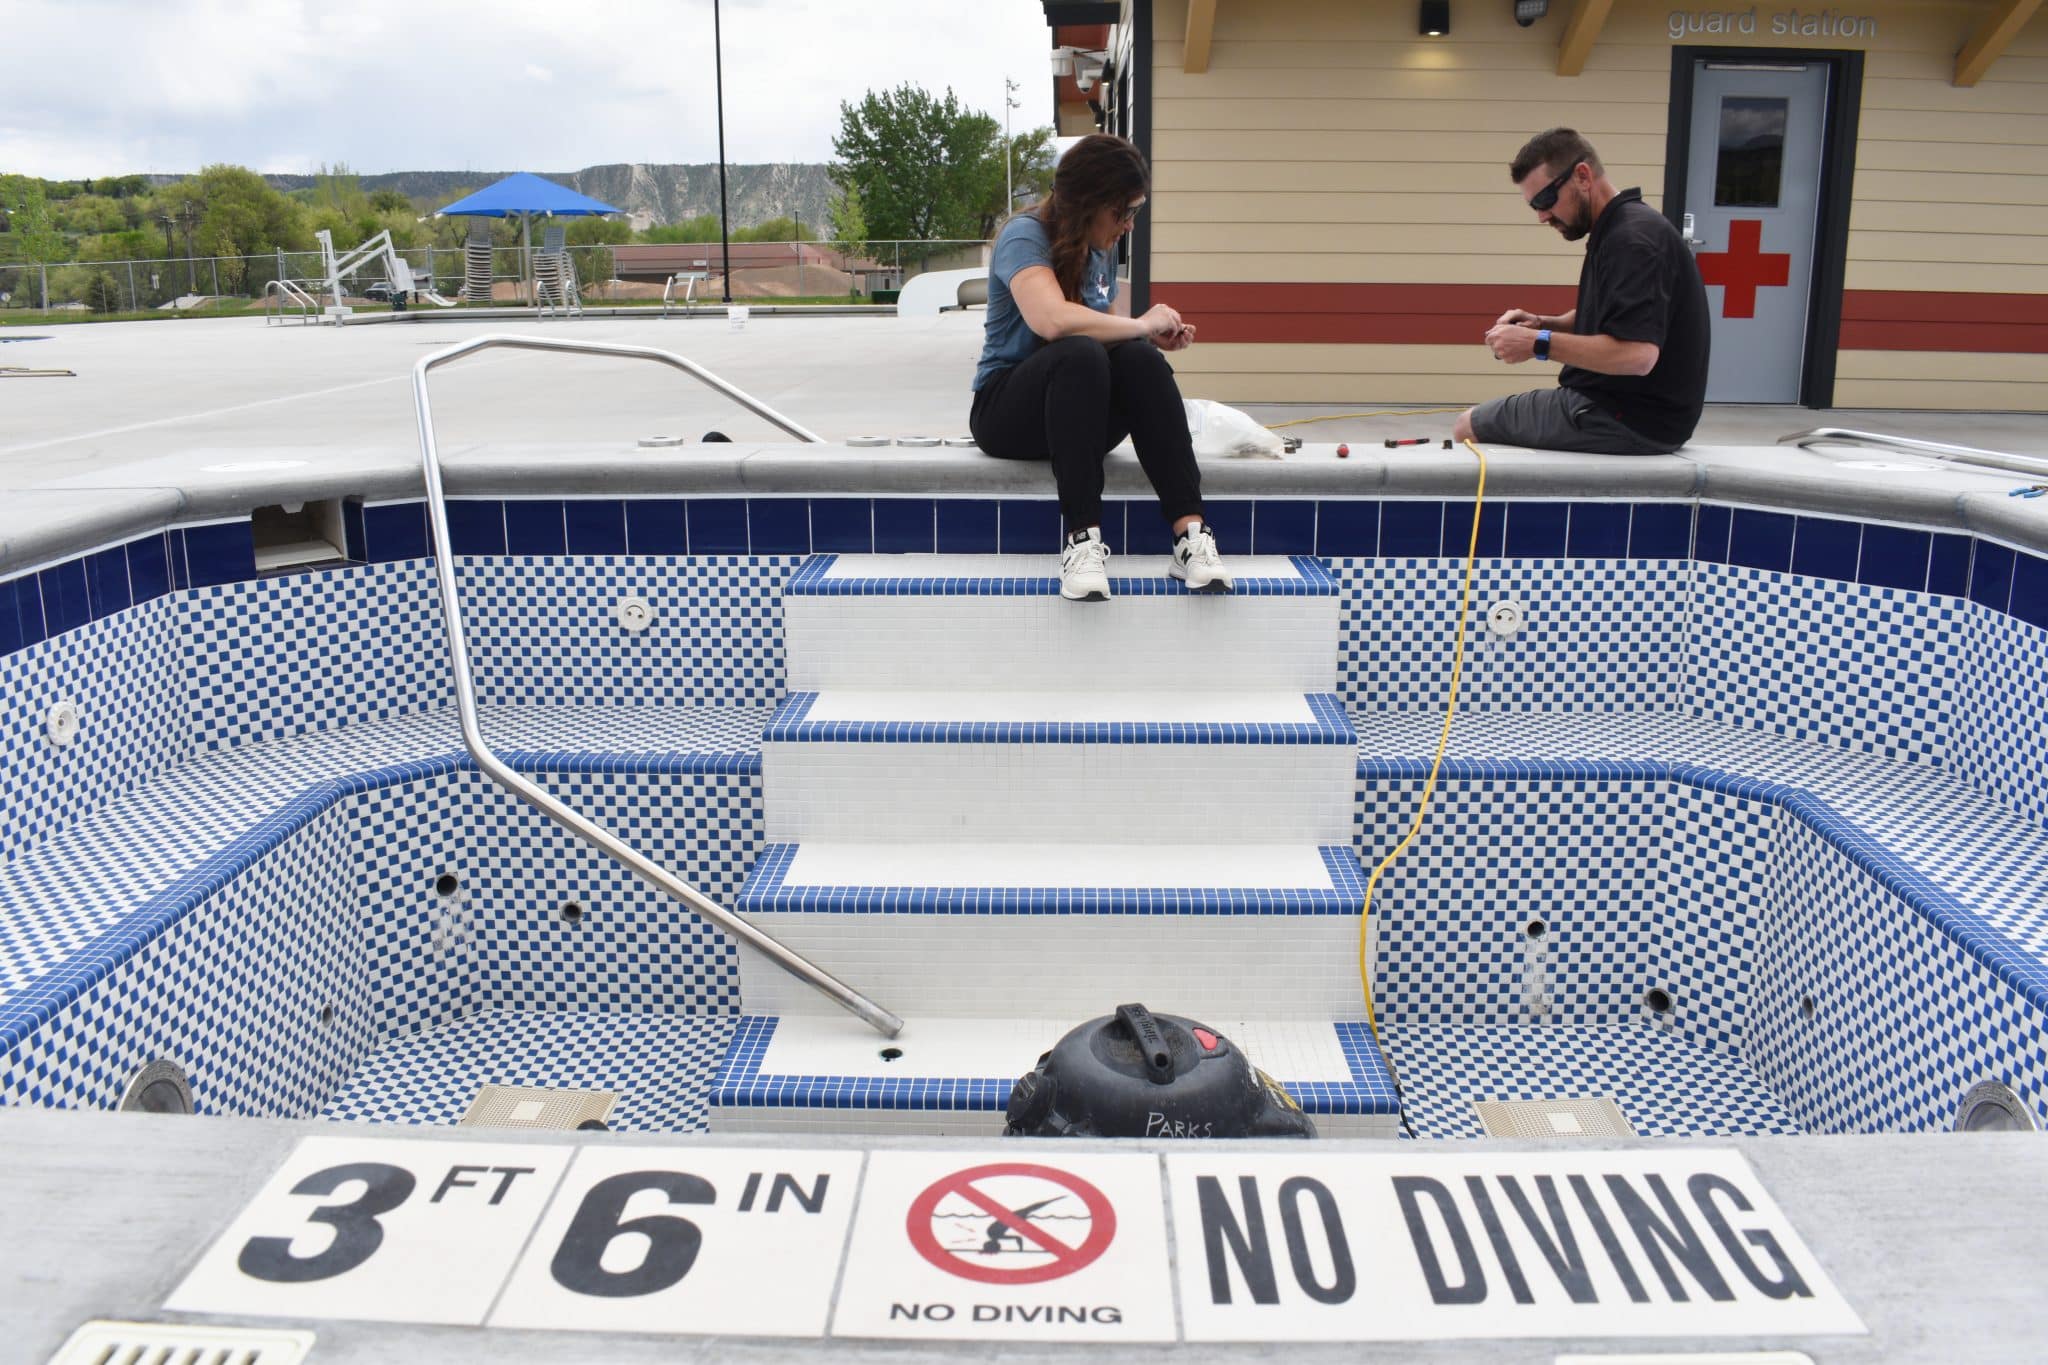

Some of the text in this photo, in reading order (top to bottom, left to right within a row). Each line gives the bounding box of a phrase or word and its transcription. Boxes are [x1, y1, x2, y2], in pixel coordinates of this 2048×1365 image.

[1667, 7, 1877, 39] guard station
[237, 1162, 831, 1298] 3 FT 6 IN
[1196, 1173, 1815, 1305] NO DIVING
[890, 1303, 1123, 1324] NO DIVING
